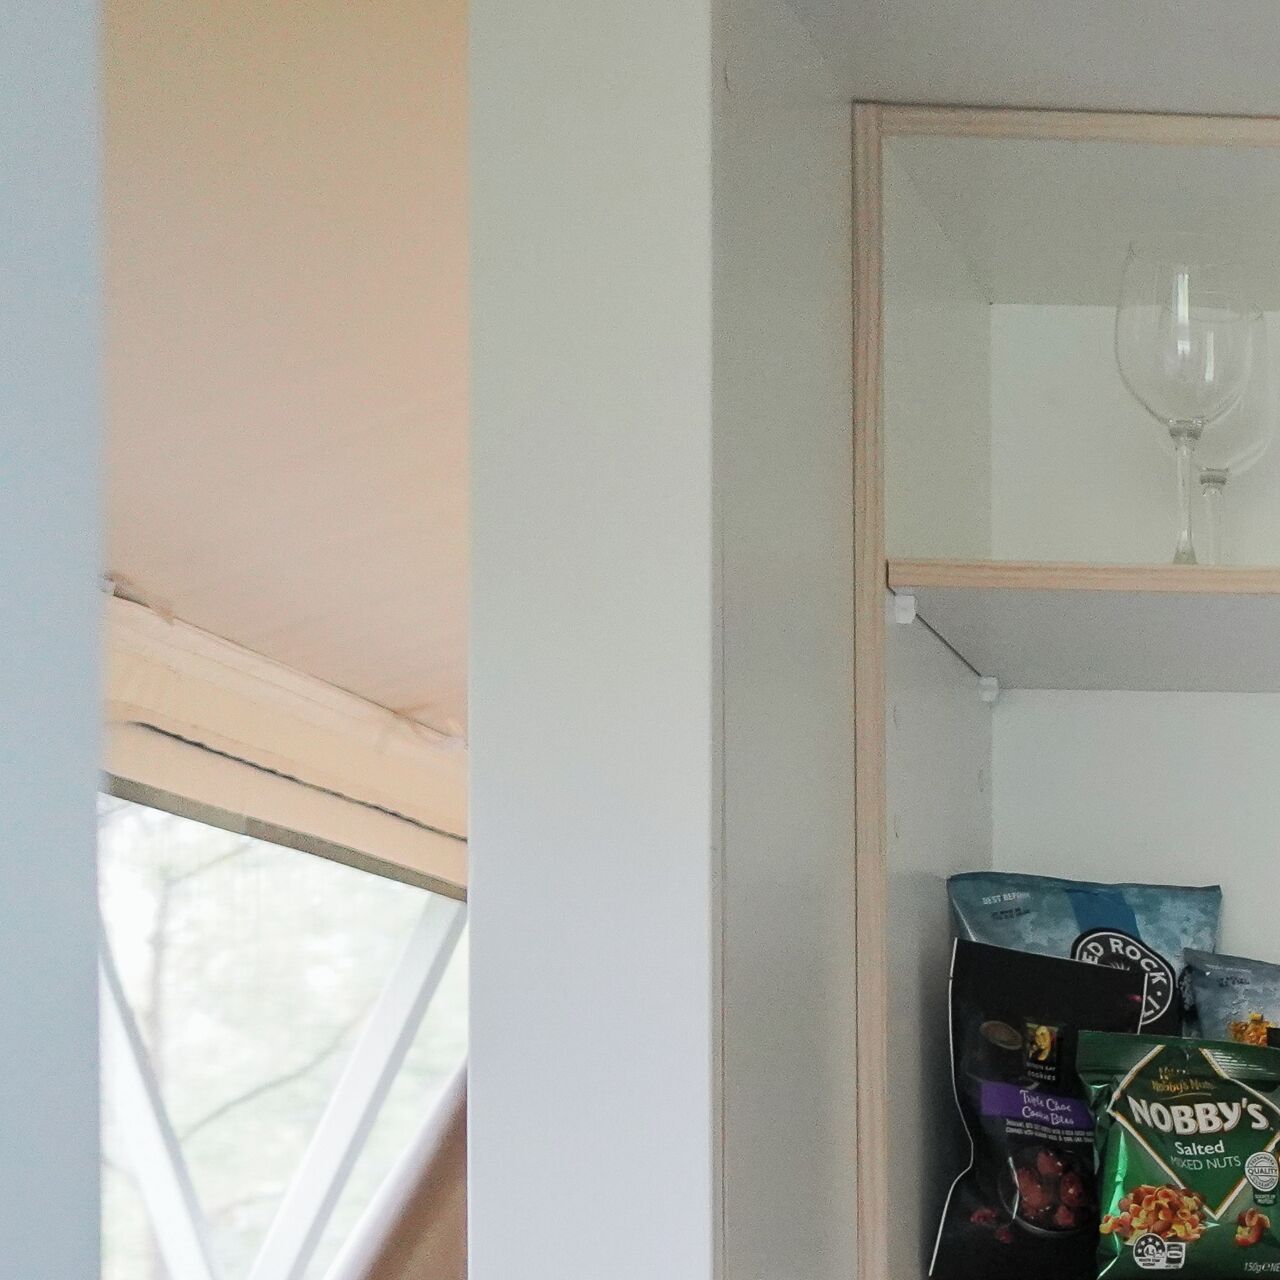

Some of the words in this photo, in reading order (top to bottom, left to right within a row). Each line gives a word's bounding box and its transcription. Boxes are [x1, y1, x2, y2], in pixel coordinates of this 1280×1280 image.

[1081, 941, 1105, 965] ED
[1108, 937, 1168, 985] ROCK
[1174, 1139, 1225, 1156] Salted
[1206, 1155, 1242, 1170] NUTS
[1247, 1167, 1278, 1175] QUALITY
